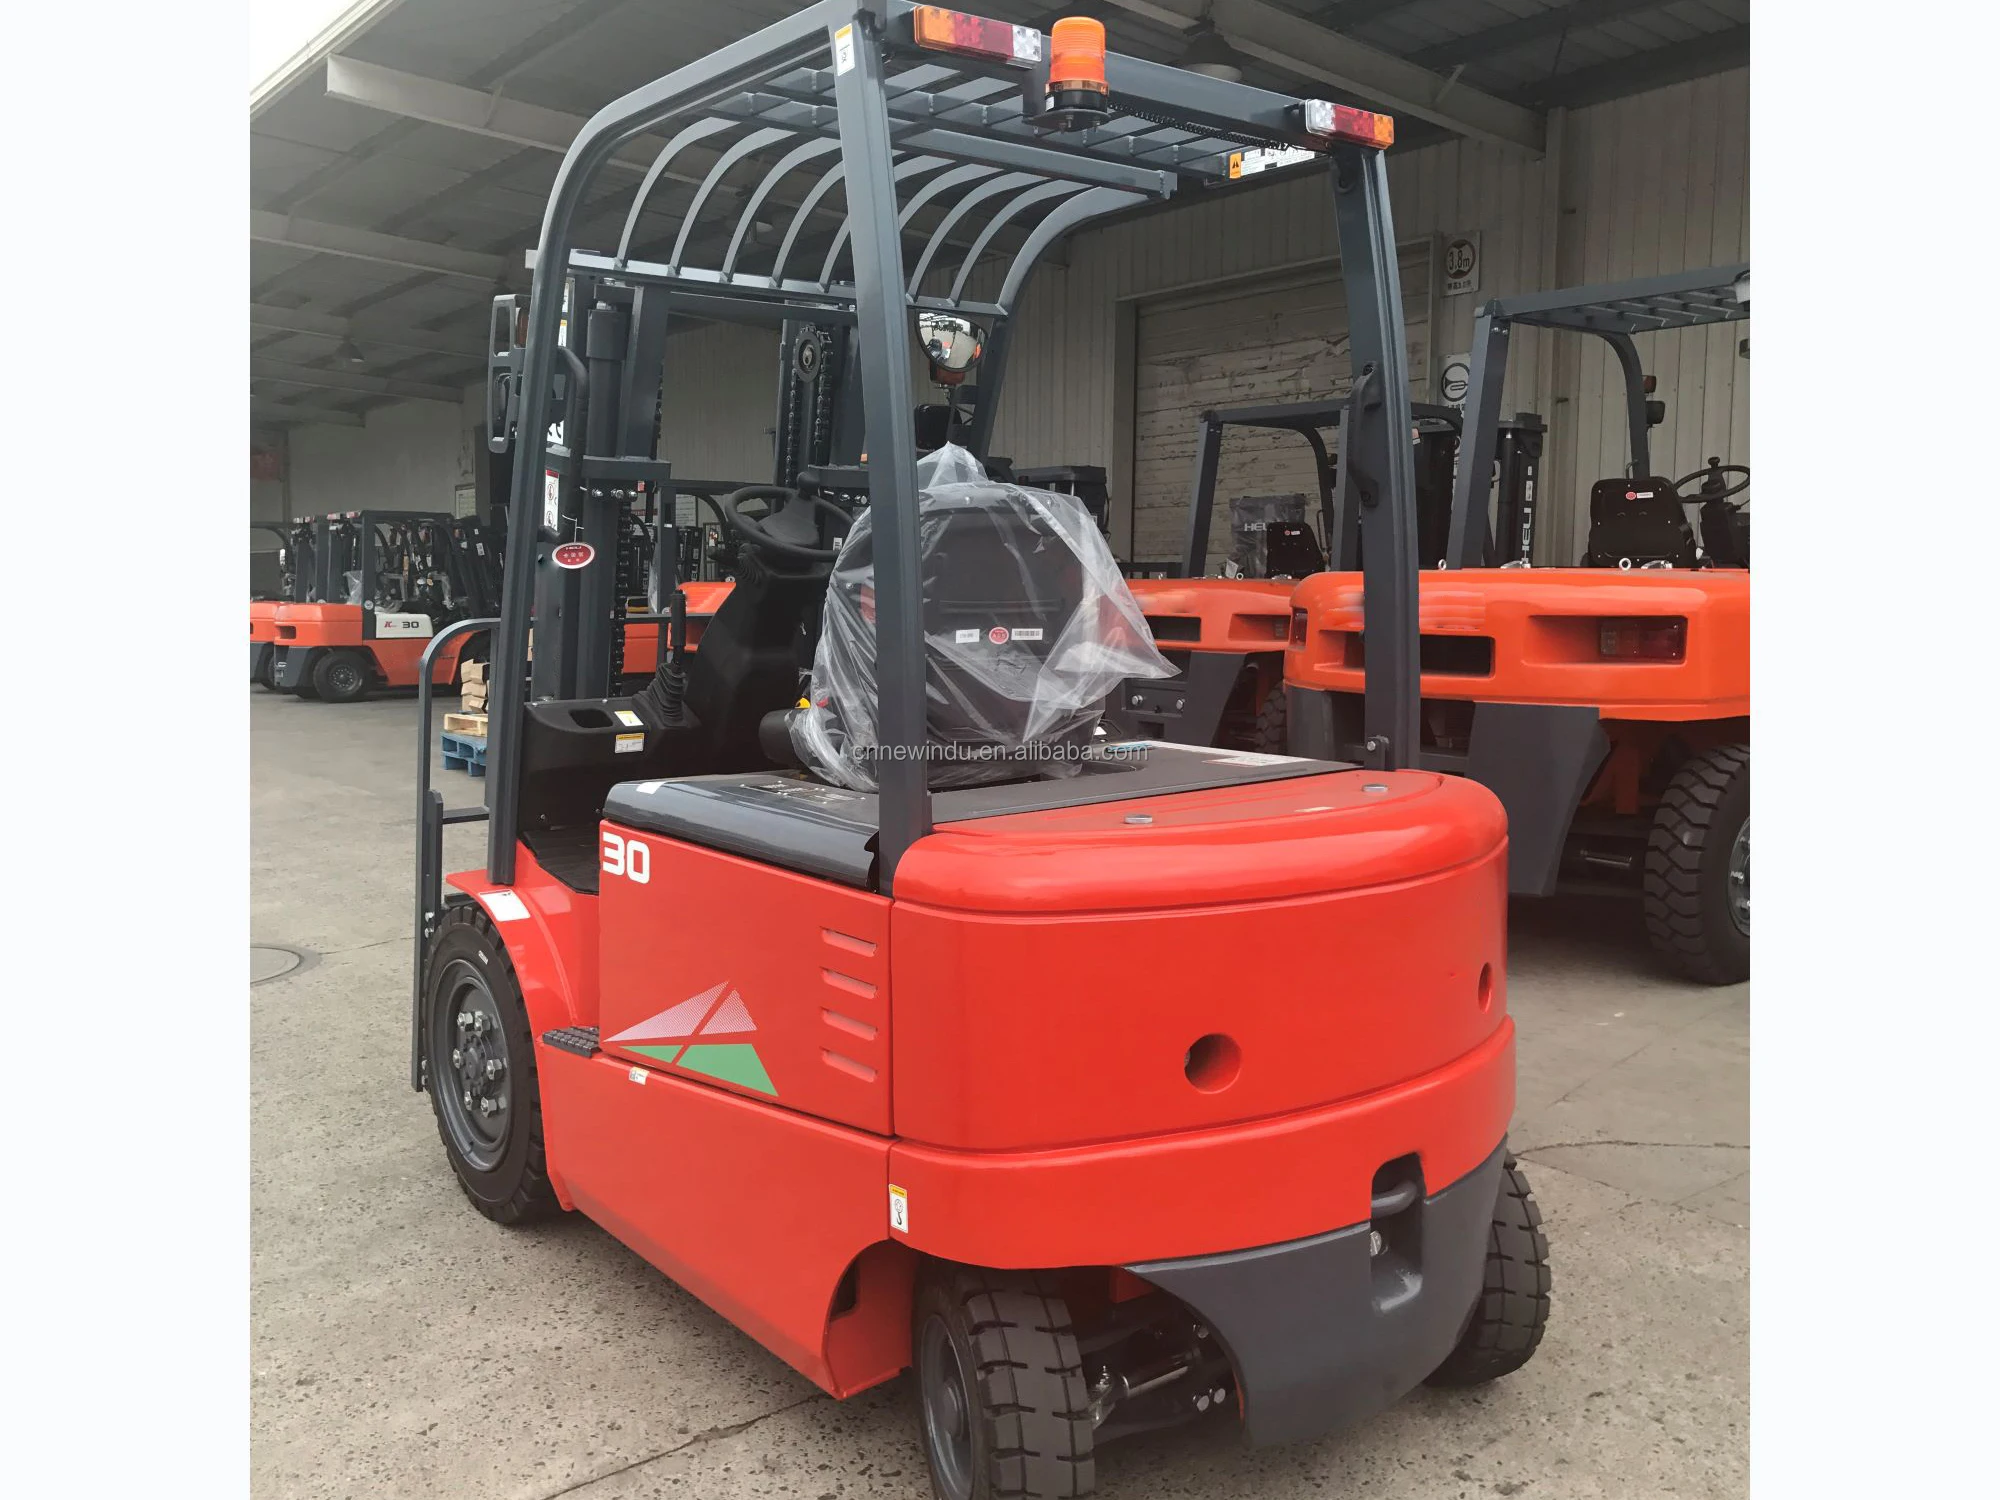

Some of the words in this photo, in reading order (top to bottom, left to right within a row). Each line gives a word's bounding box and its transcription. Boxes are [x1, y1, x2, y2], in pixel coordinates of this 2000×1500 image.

[1449, 250, 1470, 270] 3.8m
[1244, 522, 1268, 532] HEL
[1521, 507, 1532, 564] HELI
[402, 621, 420, 629] 30
[602, 831, 650, 884] 30
